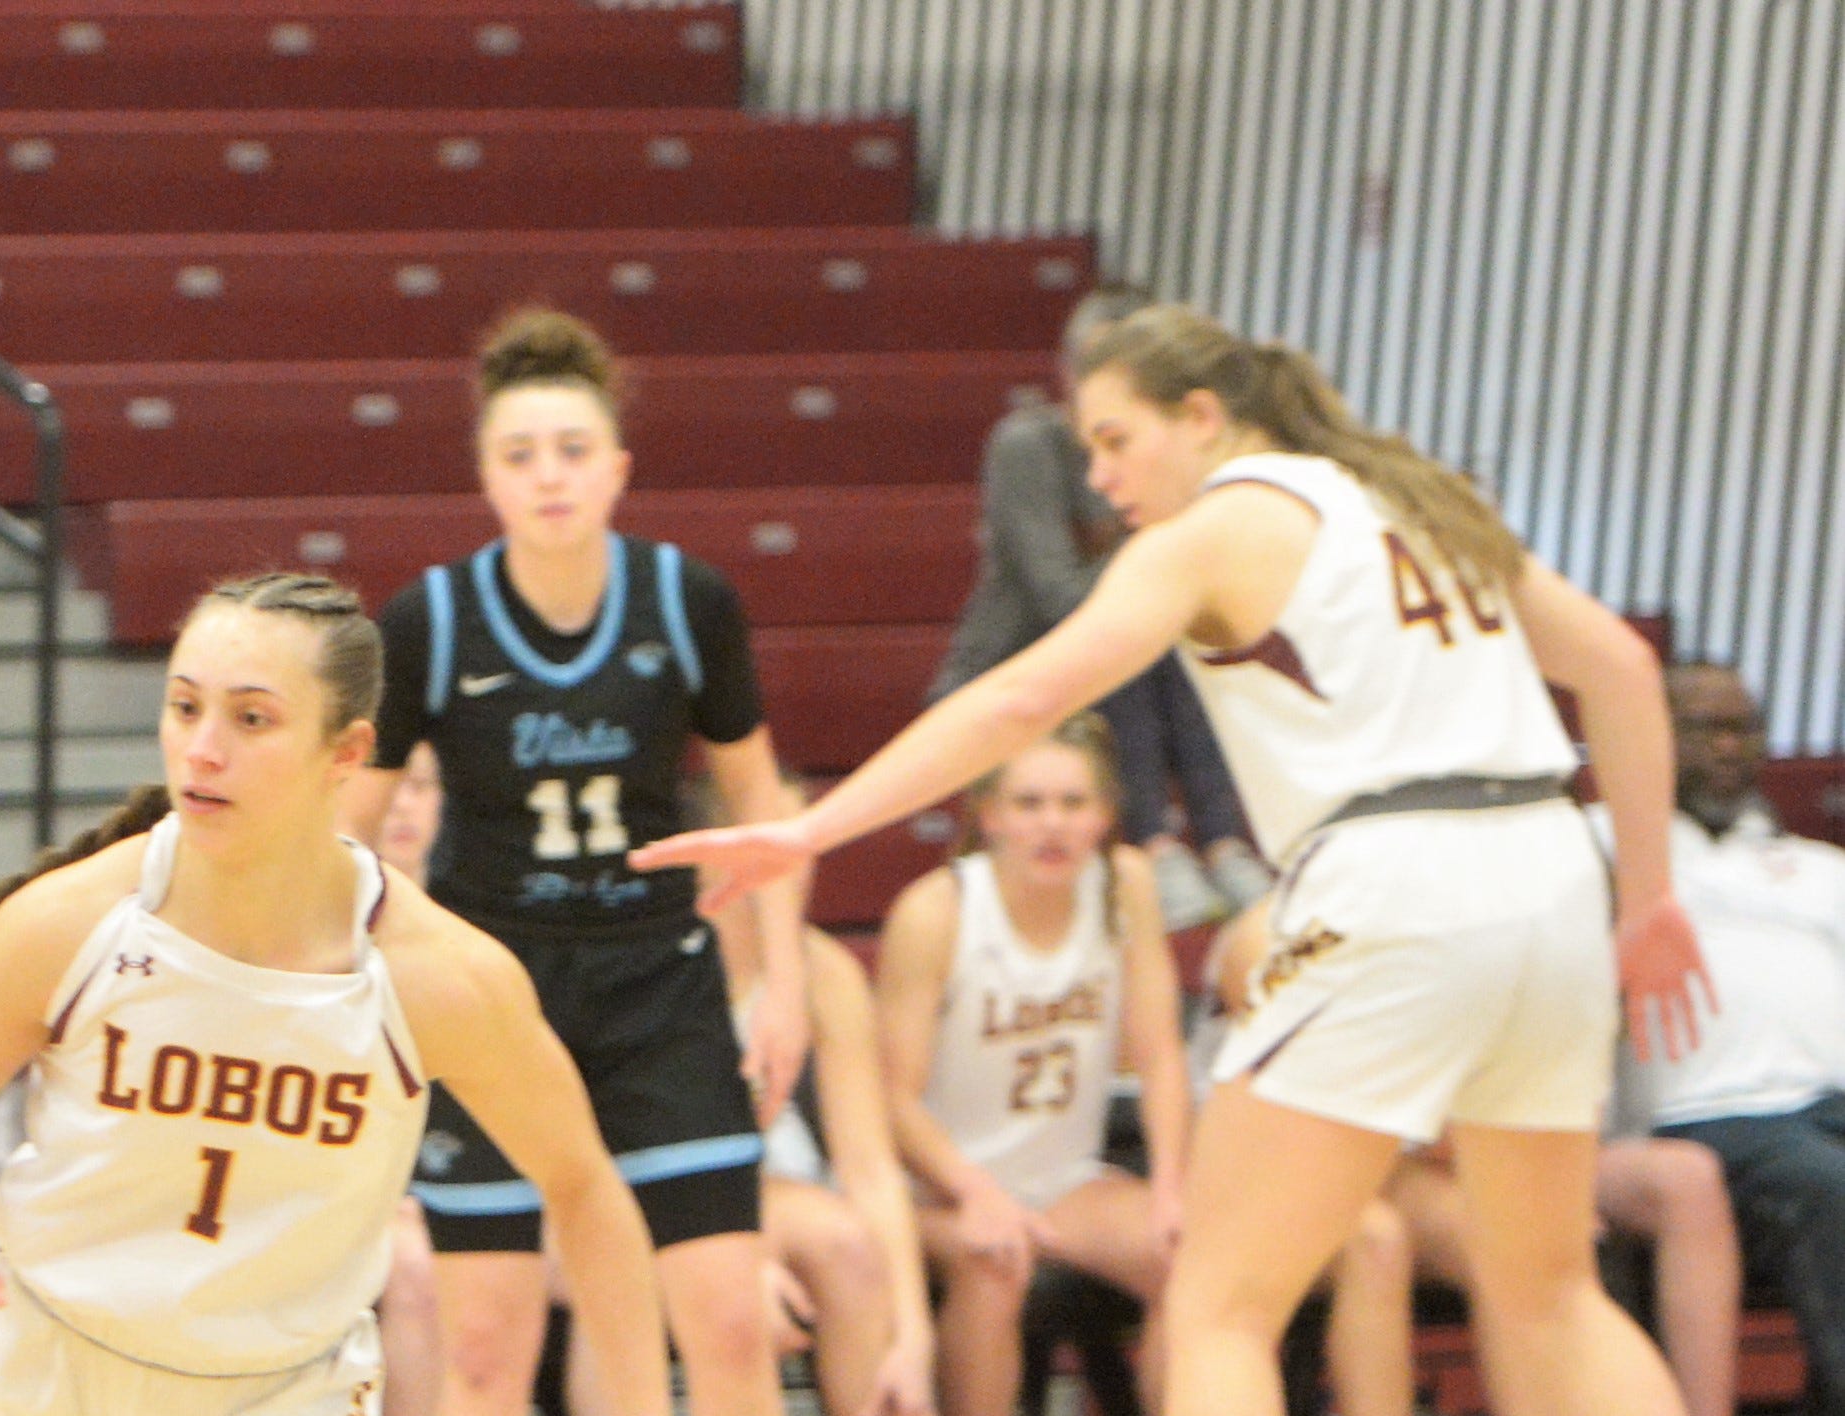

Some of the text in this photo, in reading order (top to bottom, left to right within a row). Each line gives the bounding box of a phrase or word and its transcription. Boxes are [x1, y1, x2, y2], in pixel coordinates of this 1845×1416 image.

[525, 773, 631, 862] 11
[95, 1018, 371, 1147] LOBOS
[1007, 1039, 1077, 1115] 23
[182, 1144, 234, 1243] 1
